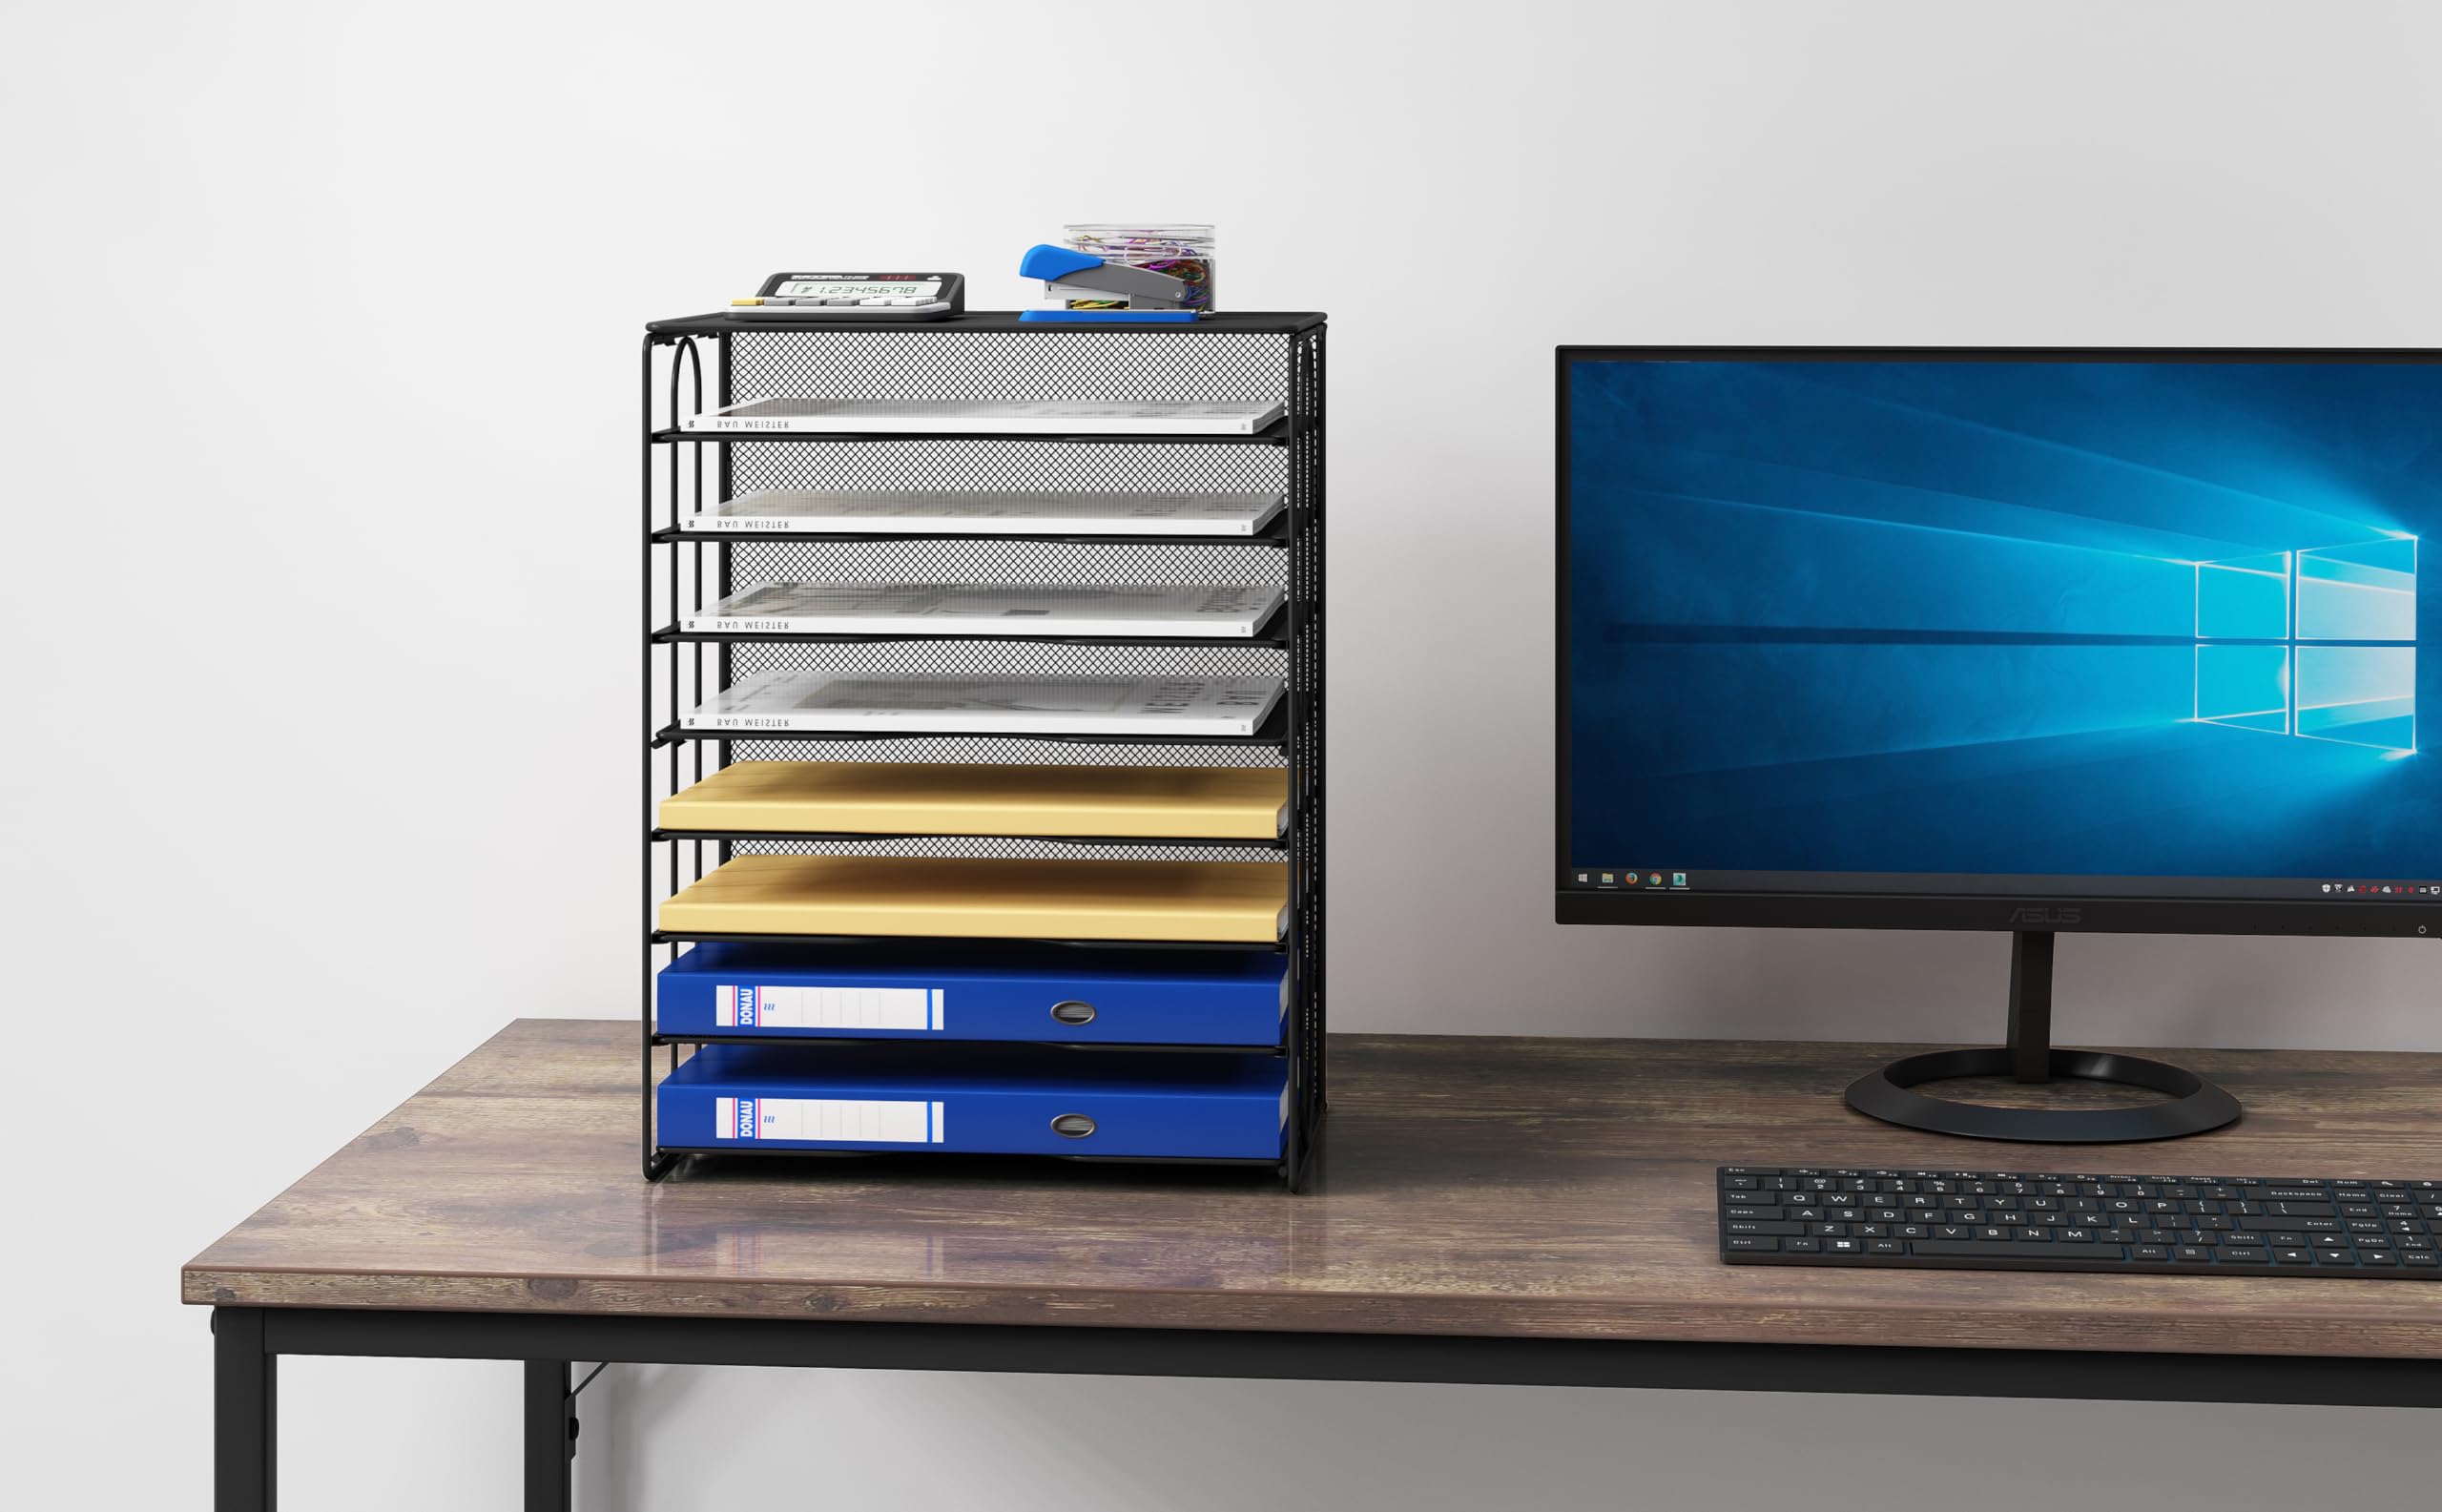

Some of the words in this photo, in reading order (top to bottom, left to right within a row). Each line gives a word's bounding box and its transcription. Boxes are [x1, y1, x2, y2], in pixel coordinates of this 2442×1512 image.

[2009, 907, 2082, 923] ASUS
[739, 988, 754, 1025] DONAU
[739, 1100, 754, 1137] DONAU
